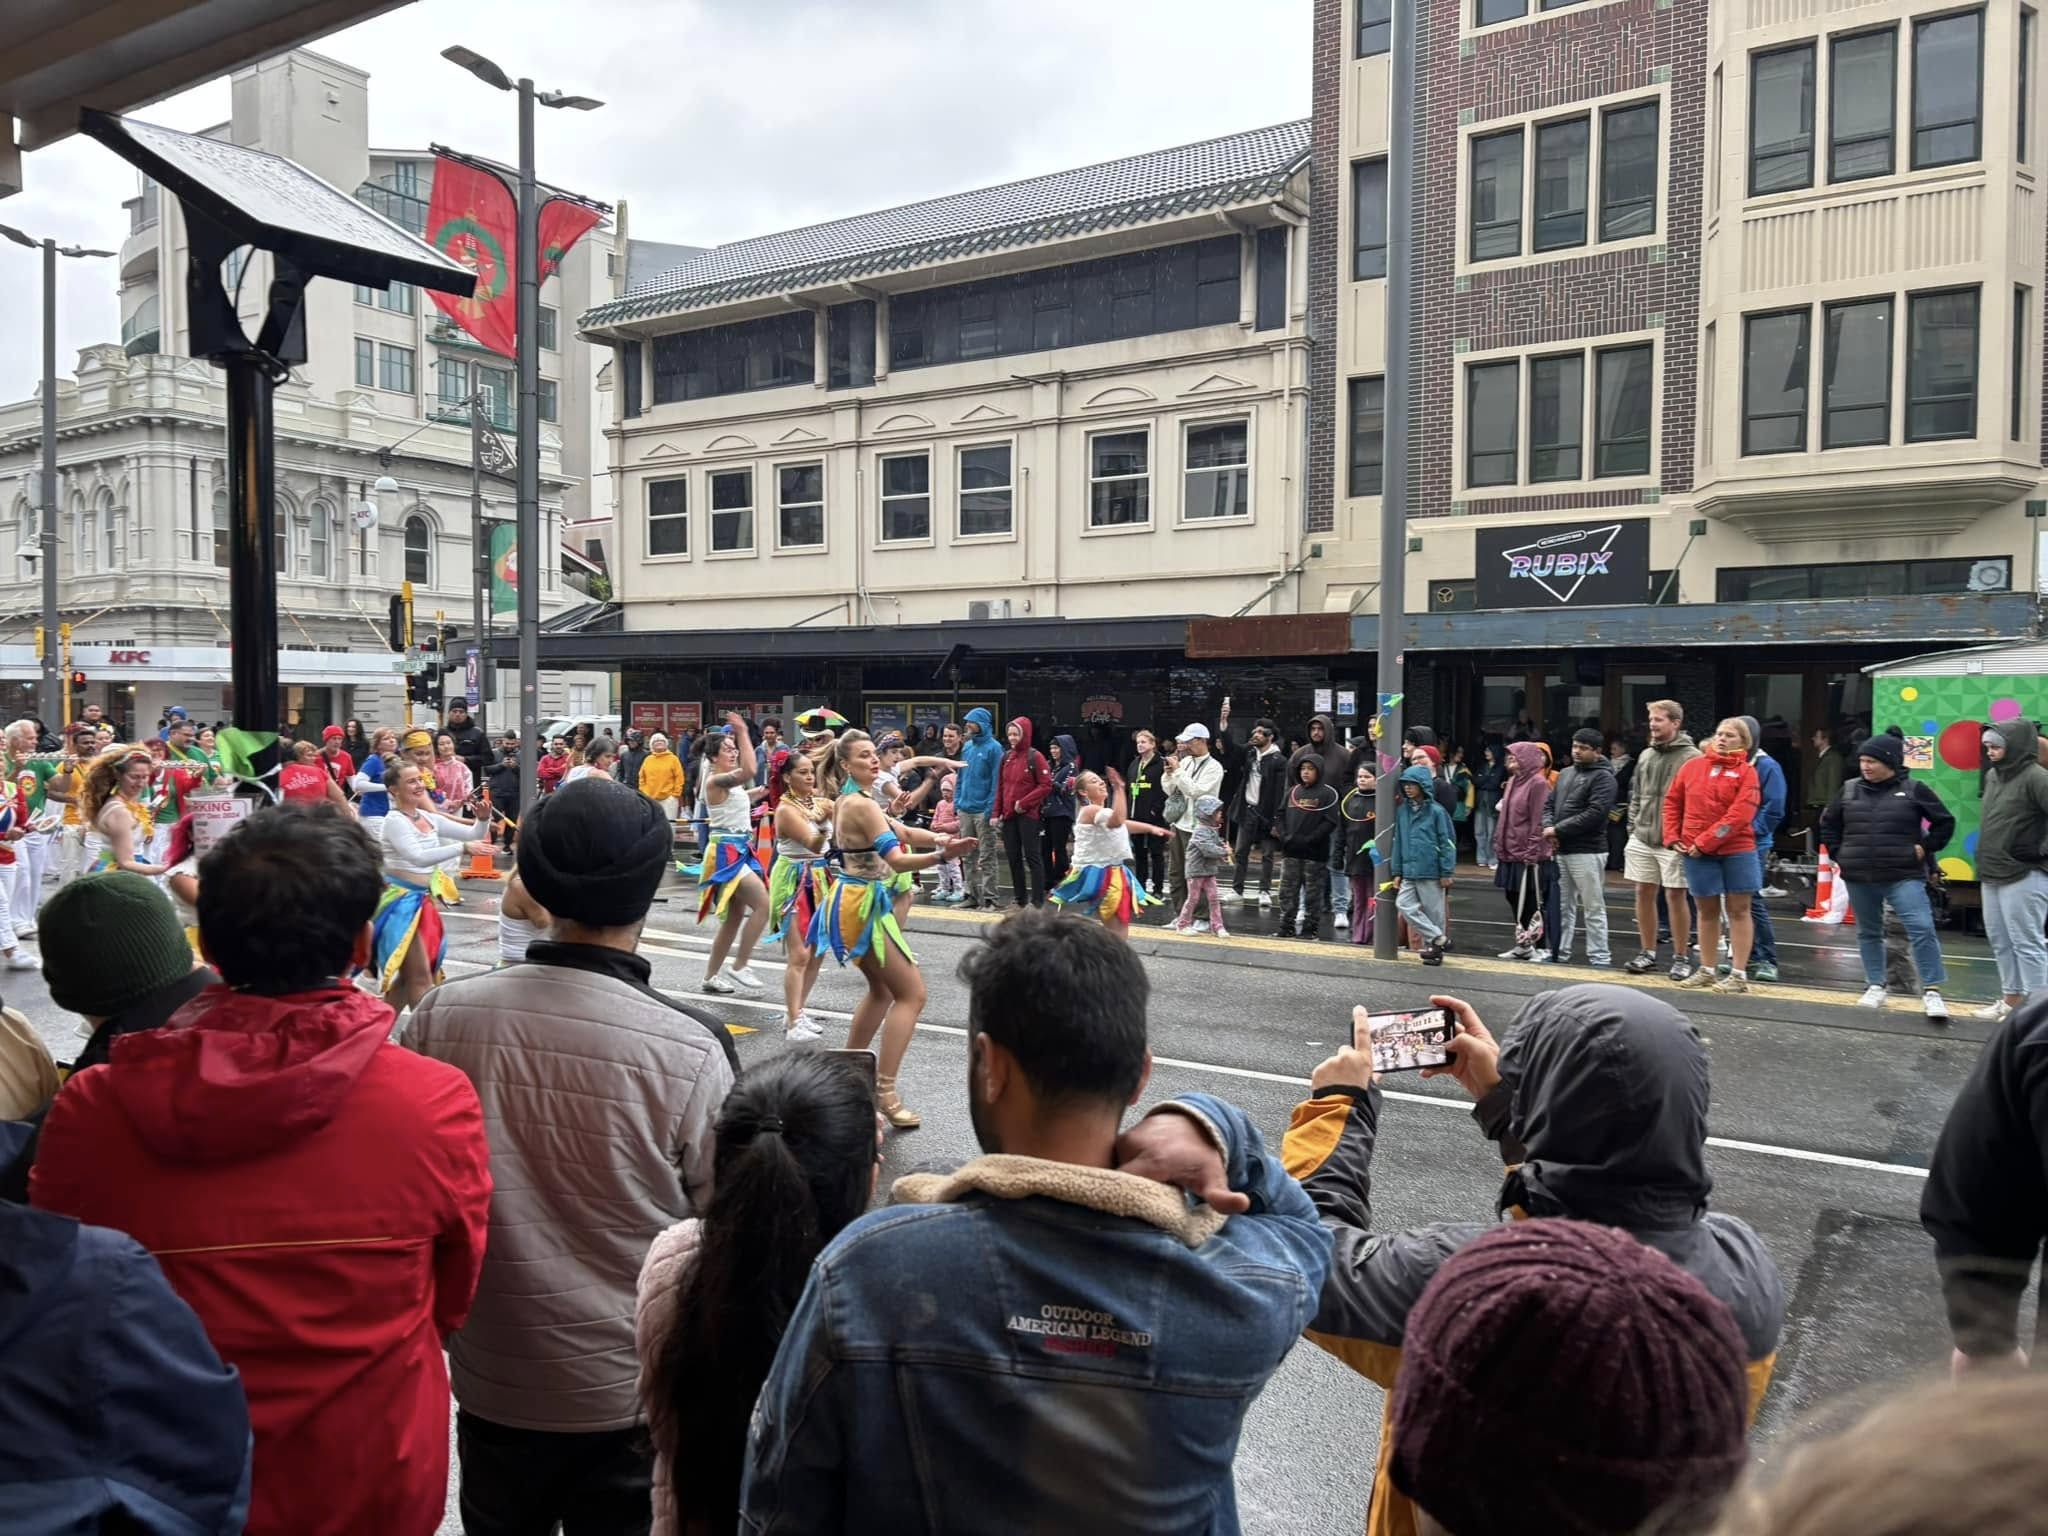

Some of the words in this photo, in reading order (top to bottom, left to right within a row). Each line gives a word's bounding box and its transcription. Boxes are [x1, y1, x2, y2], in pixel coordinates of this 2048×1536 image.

[1509, 551, 1613, 578] RUBIX
[109, 650, 151, 664] KFC
[190, 801, 232, 812] RKING
[1040, 1304, 1115, 1325] OUTDOOR
[1007, 1315, 1088, 1338] AMERICAN
[1091, 1326, 1153, 1347] LEGEND
